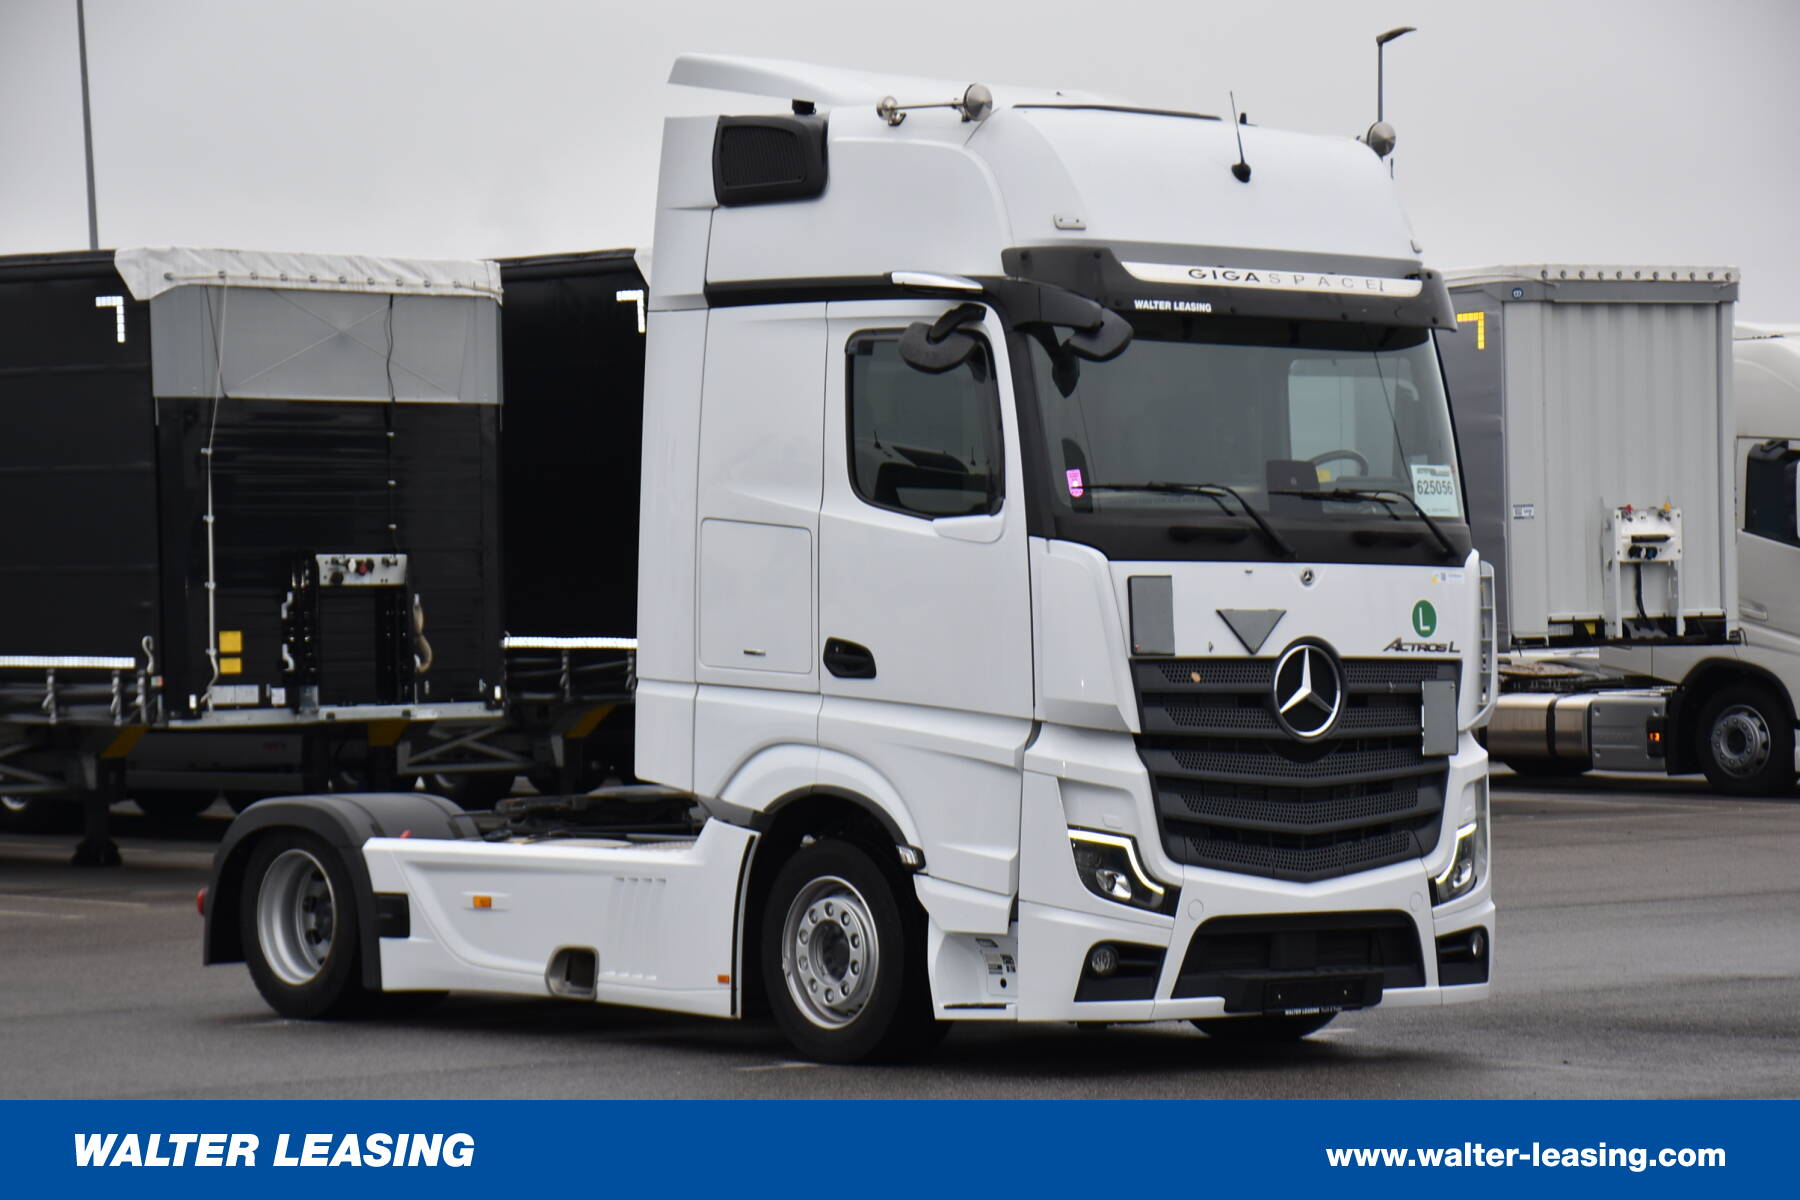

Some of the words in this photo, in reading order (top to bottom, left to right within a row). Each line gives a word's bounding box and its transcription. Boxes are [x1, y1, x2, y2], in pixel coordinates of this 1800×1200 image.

[1134, 299, 1171, 310] WALTER
[1173, 301, 1212, 313] LEASING
[1416, 479, 1453, 496] 625056
[1418, 606, 1431, 632] L
